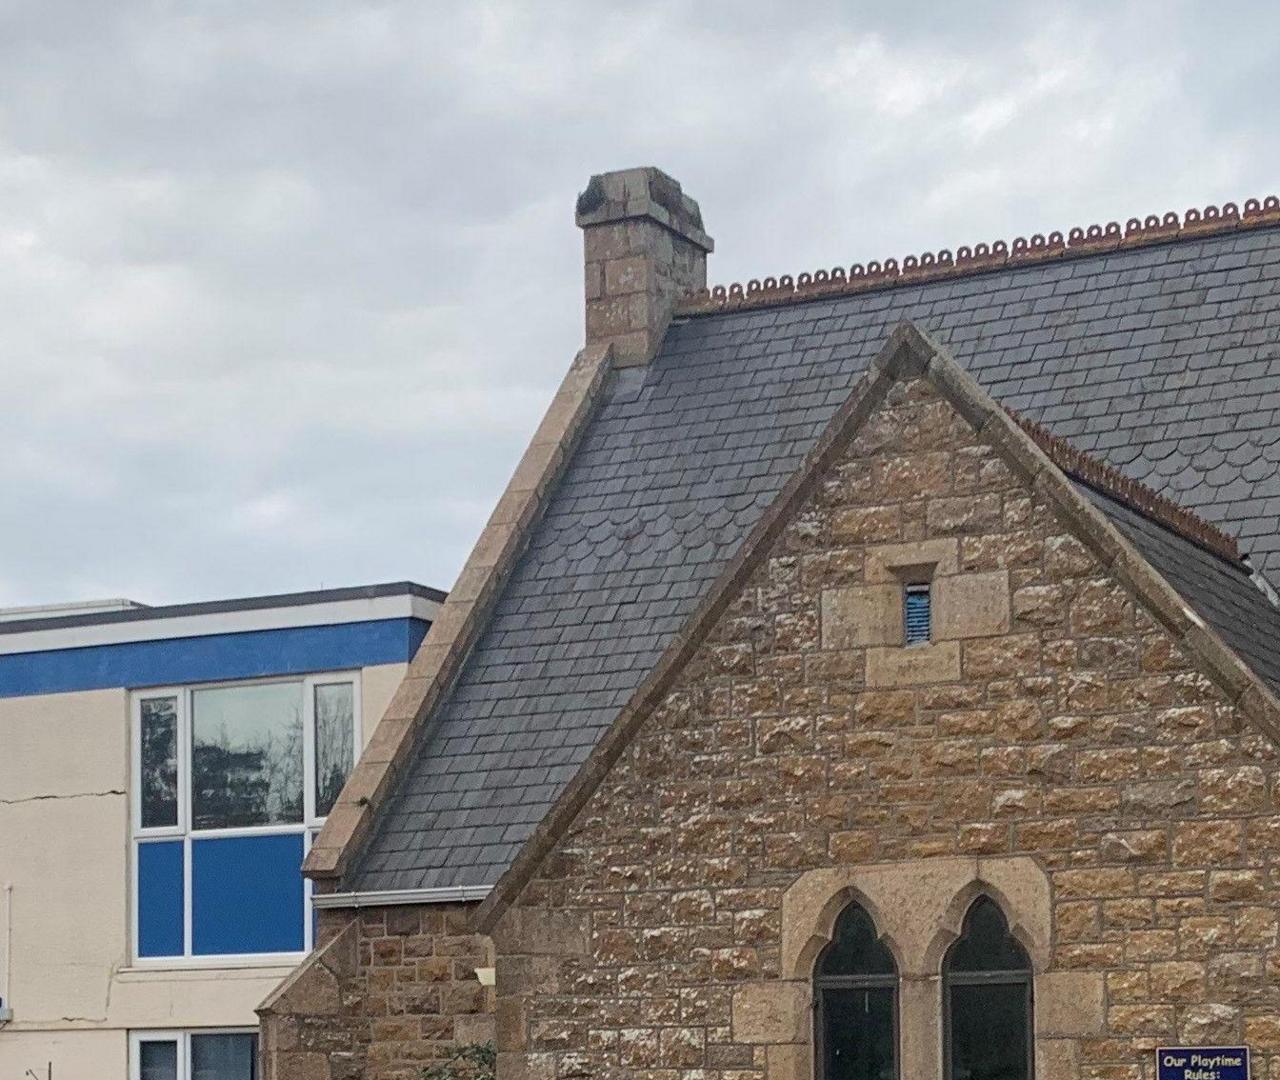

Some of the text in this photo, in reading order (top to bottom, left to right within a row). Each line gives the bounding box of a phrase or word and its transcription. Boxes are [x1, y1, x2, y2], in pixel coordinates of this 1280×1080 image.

[1163, 1054, 1242, 1069] Our Playtime
[1184, 1069, 1221, 1080] Rules:
